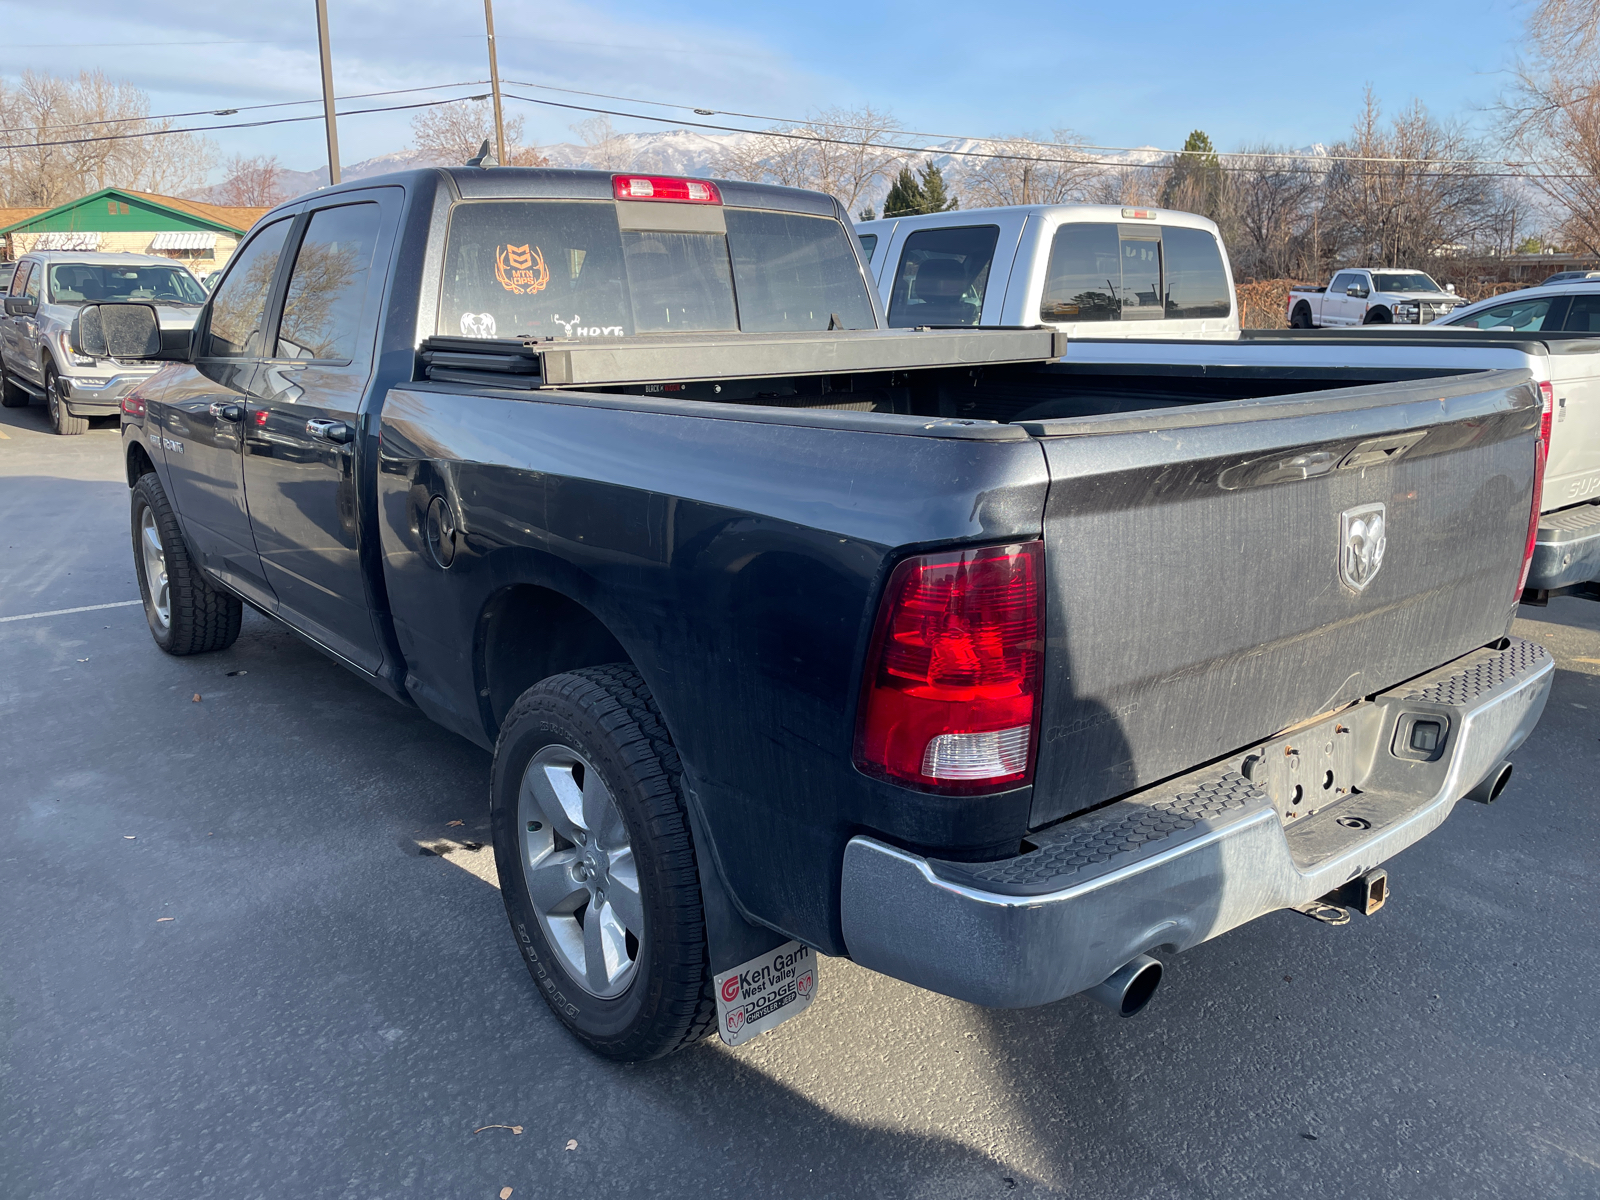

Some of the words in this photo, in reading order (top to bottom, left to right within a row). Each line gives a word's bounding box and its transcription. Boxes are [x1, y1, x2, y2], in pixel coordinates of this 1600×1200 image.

[512, 270, 534, 278] MTN
[513, 277, 536, 285] OPS
[645, 384, 660, 393] BLACK
[739, 965, 771, 991] Ken
[741, 981, 767, 1000] West
[768, 966, 797, 987] Valley
[745, 980, 796, 1014] DODGE
[746, 1002, 779, 1023] CHRYSLER
[782, 993, 796, 1006] JEEP
